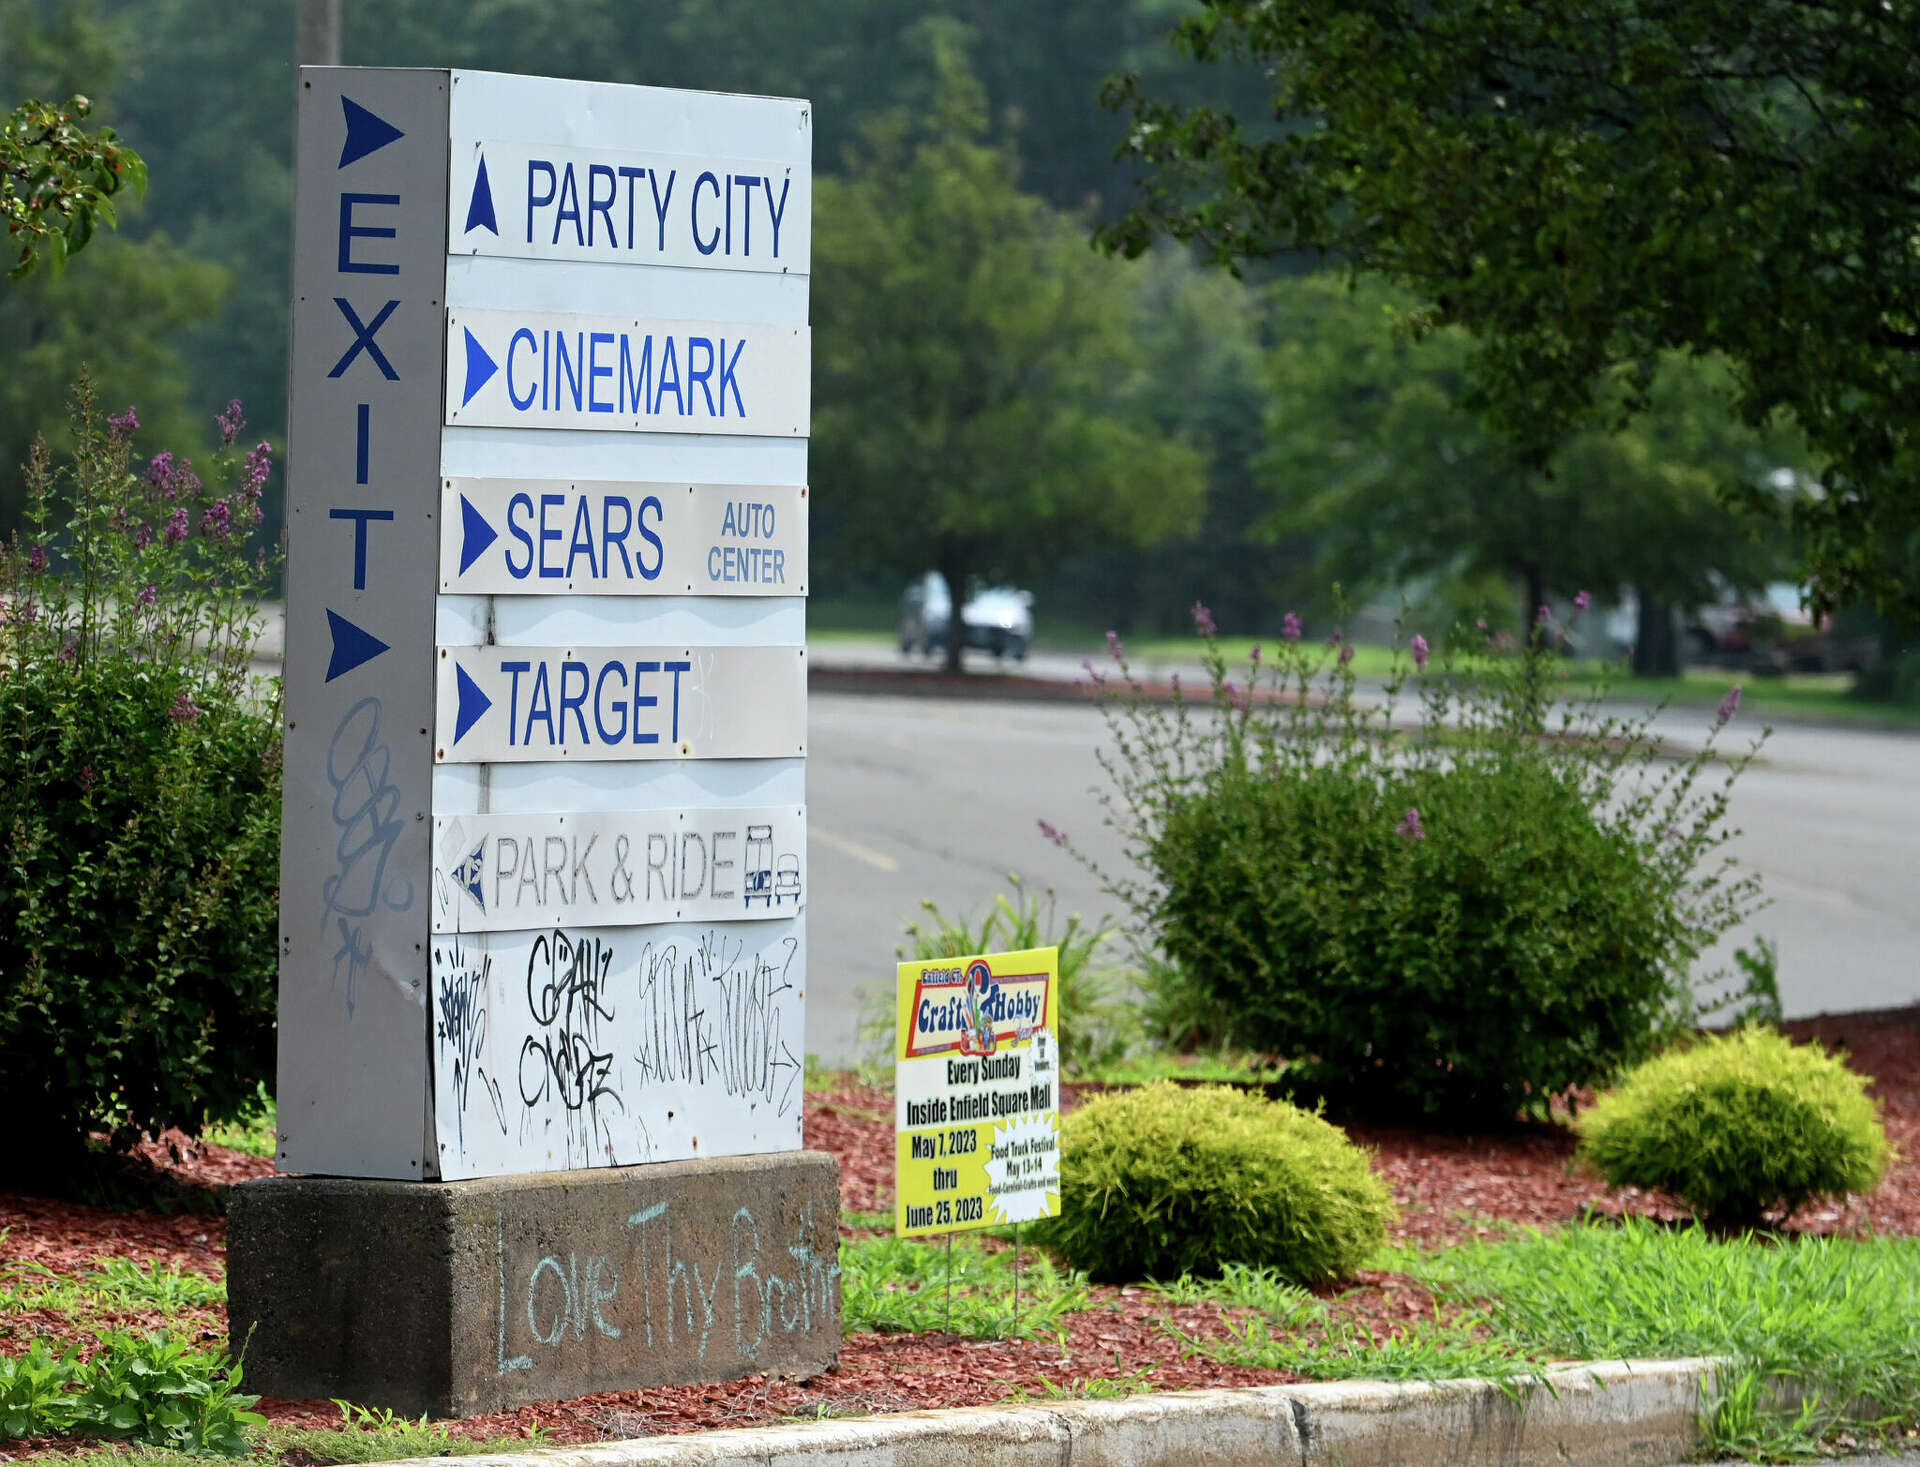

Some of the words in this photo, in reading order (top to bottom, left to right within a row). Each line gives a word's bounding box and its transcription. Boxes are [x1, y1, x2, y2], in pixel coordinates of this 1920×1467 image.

[526, 159, 677, 252] PARTY
[691, 171, 791, 259] CITY
[327, 192, 401, 591] EXIT
[506, 327, 747, 418] CINEMARK
[505, 492, 664, 580] SEARS
[721, 501, 776, 539] AUTO
[707, 546, 786, 585] CENTER
[500, 660, 691, 746] TARGET
[493, 831, 599, 908] PARK
[611, 832, 635, 903] &
[647, 831, 737, 902] RIDE
[918, 996, 964, 1034] Craft
[993, 989, 1041, 1024] Hobby
[947, 1058, 980, 1085] Every
[981, 1055, 1021, 1080] Sunday
[907, 1098, 947, 1126] Inside
[950, 1091, 990, 1121] Enfield
[991, 1088, 1029, 1117] Square
[1030, 1083, 1051, 1112] Mall
[911, 1134, 936, 1160] May
[938, 1133, 947, 1157] 7,
[949, 1129, 977, 1155] 2023
[991, 1143, 1009, 1160] Food
[1011, 1139, 1029, 1157] Truck
[1030, 1135, 1055, 1154] Festival
[933, 1165, 957, 1191] thru
[1006, 1160, 1020, 1180] May
[1022, 1155, 1043, 1175] 13-14
[906, 1203, 933, 1229] June
[935, 1199, 953, 1225] 25,
[954, 1195, 983, 1222] 2023
